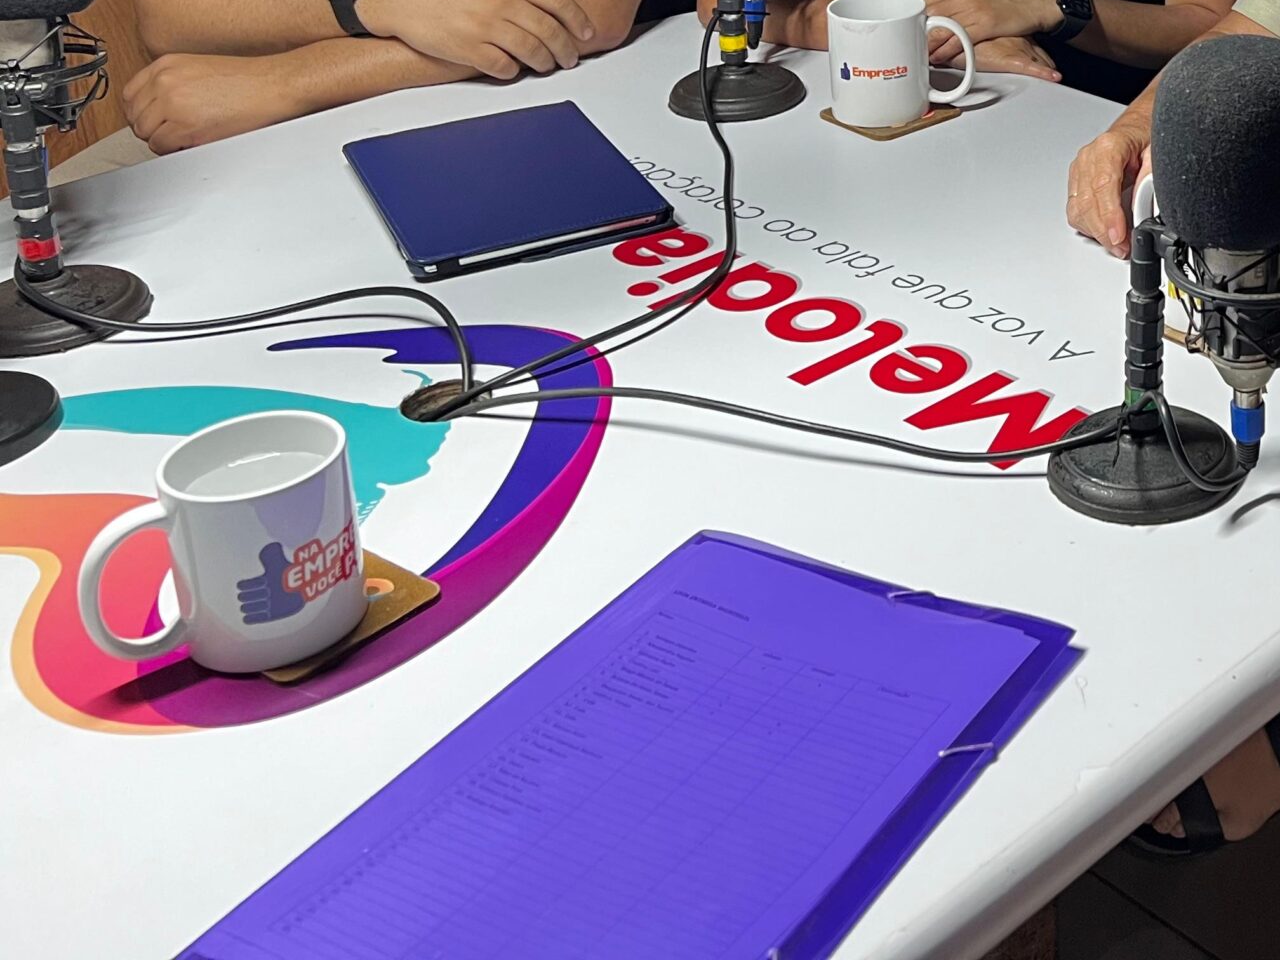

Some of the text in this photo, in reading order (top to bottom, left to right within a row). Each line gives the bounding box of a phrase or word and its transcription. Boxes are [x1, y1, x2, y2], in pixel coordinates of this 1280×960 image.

[852, 65, 908, 79] Empresta
[764, 219, 816, 242] ao
[813, 240, 893, 279] fala
[892, 273, 973, 309] que
[969, 306, 1044, 345] voz
[612, 228, 1089, 470] Melodia
[1049, 340, 1095, 361] A
[300, 543, 319, 562] NA
